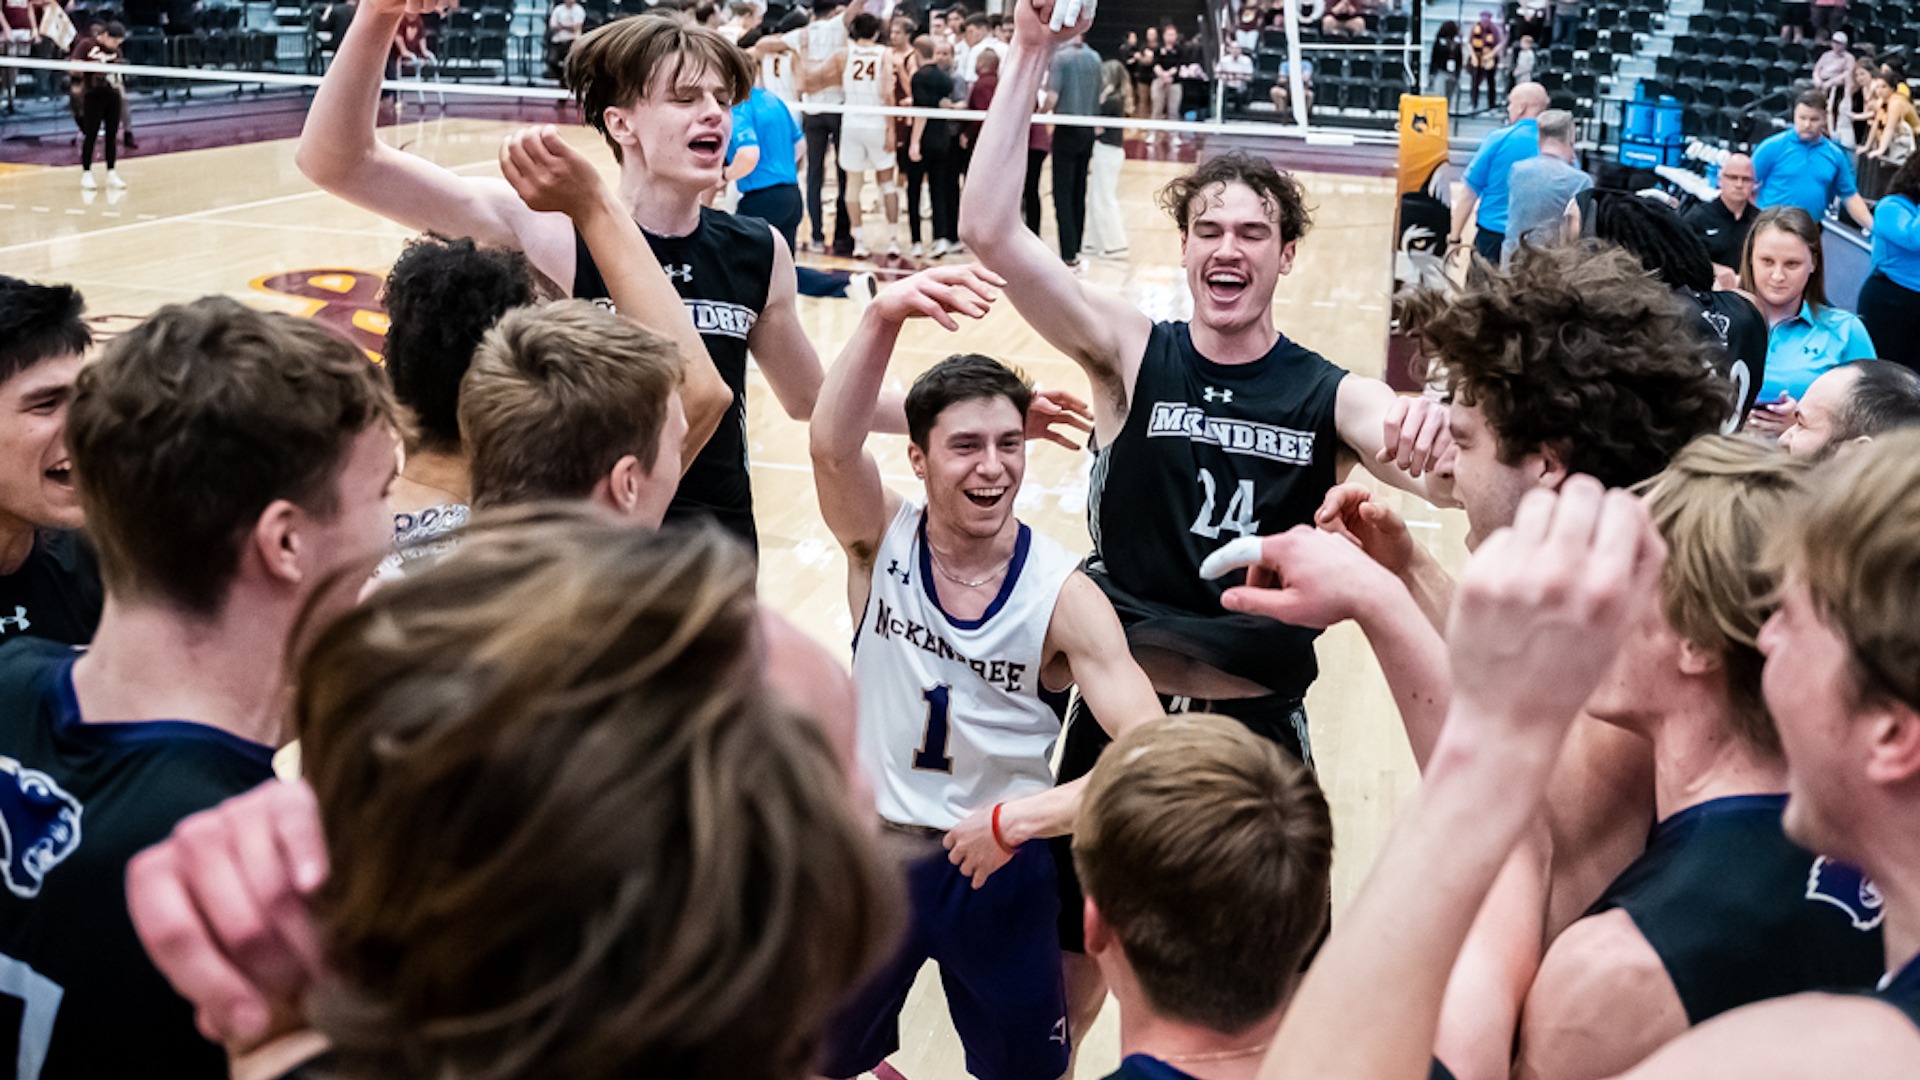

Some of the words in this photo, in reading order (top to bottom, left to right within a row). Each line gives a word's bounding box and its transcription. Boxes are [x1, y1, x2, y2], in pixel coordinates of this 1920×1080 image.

[853, 60, 876, 81] 24
[1190, 468, 1260, 539] 24
[912, 681, 954, 775] 1
